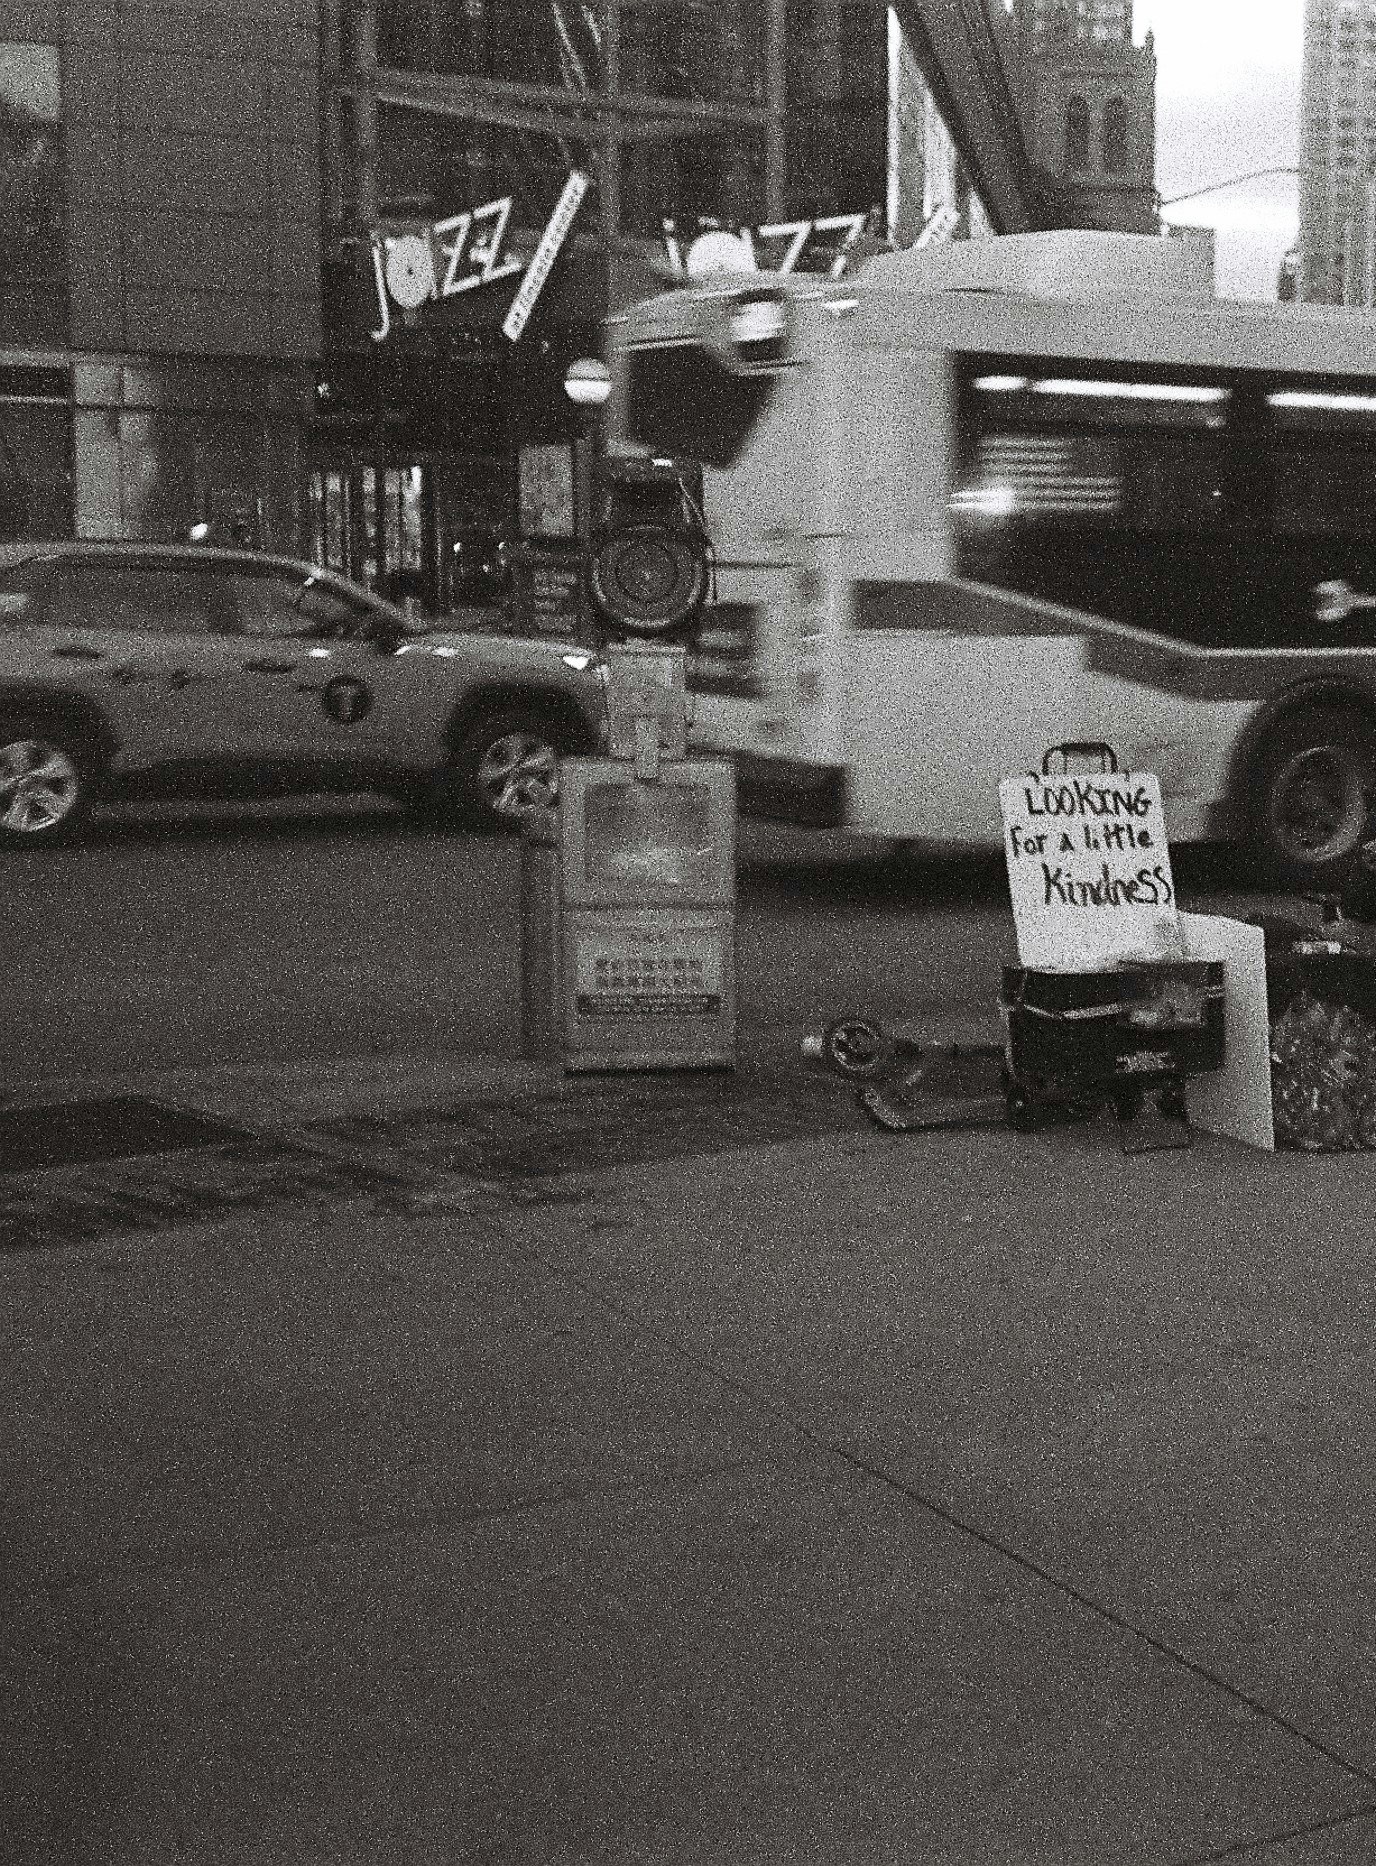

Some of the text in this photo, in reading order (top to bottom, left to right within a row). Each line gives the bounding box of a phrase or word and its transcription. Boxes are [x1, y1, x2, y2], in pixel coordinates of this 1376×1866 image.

[1024, 780, 1152, 818] LOOKING
[1083, 822, 1154, 851] little
[1041, 862, 1173, 906] Kindness
